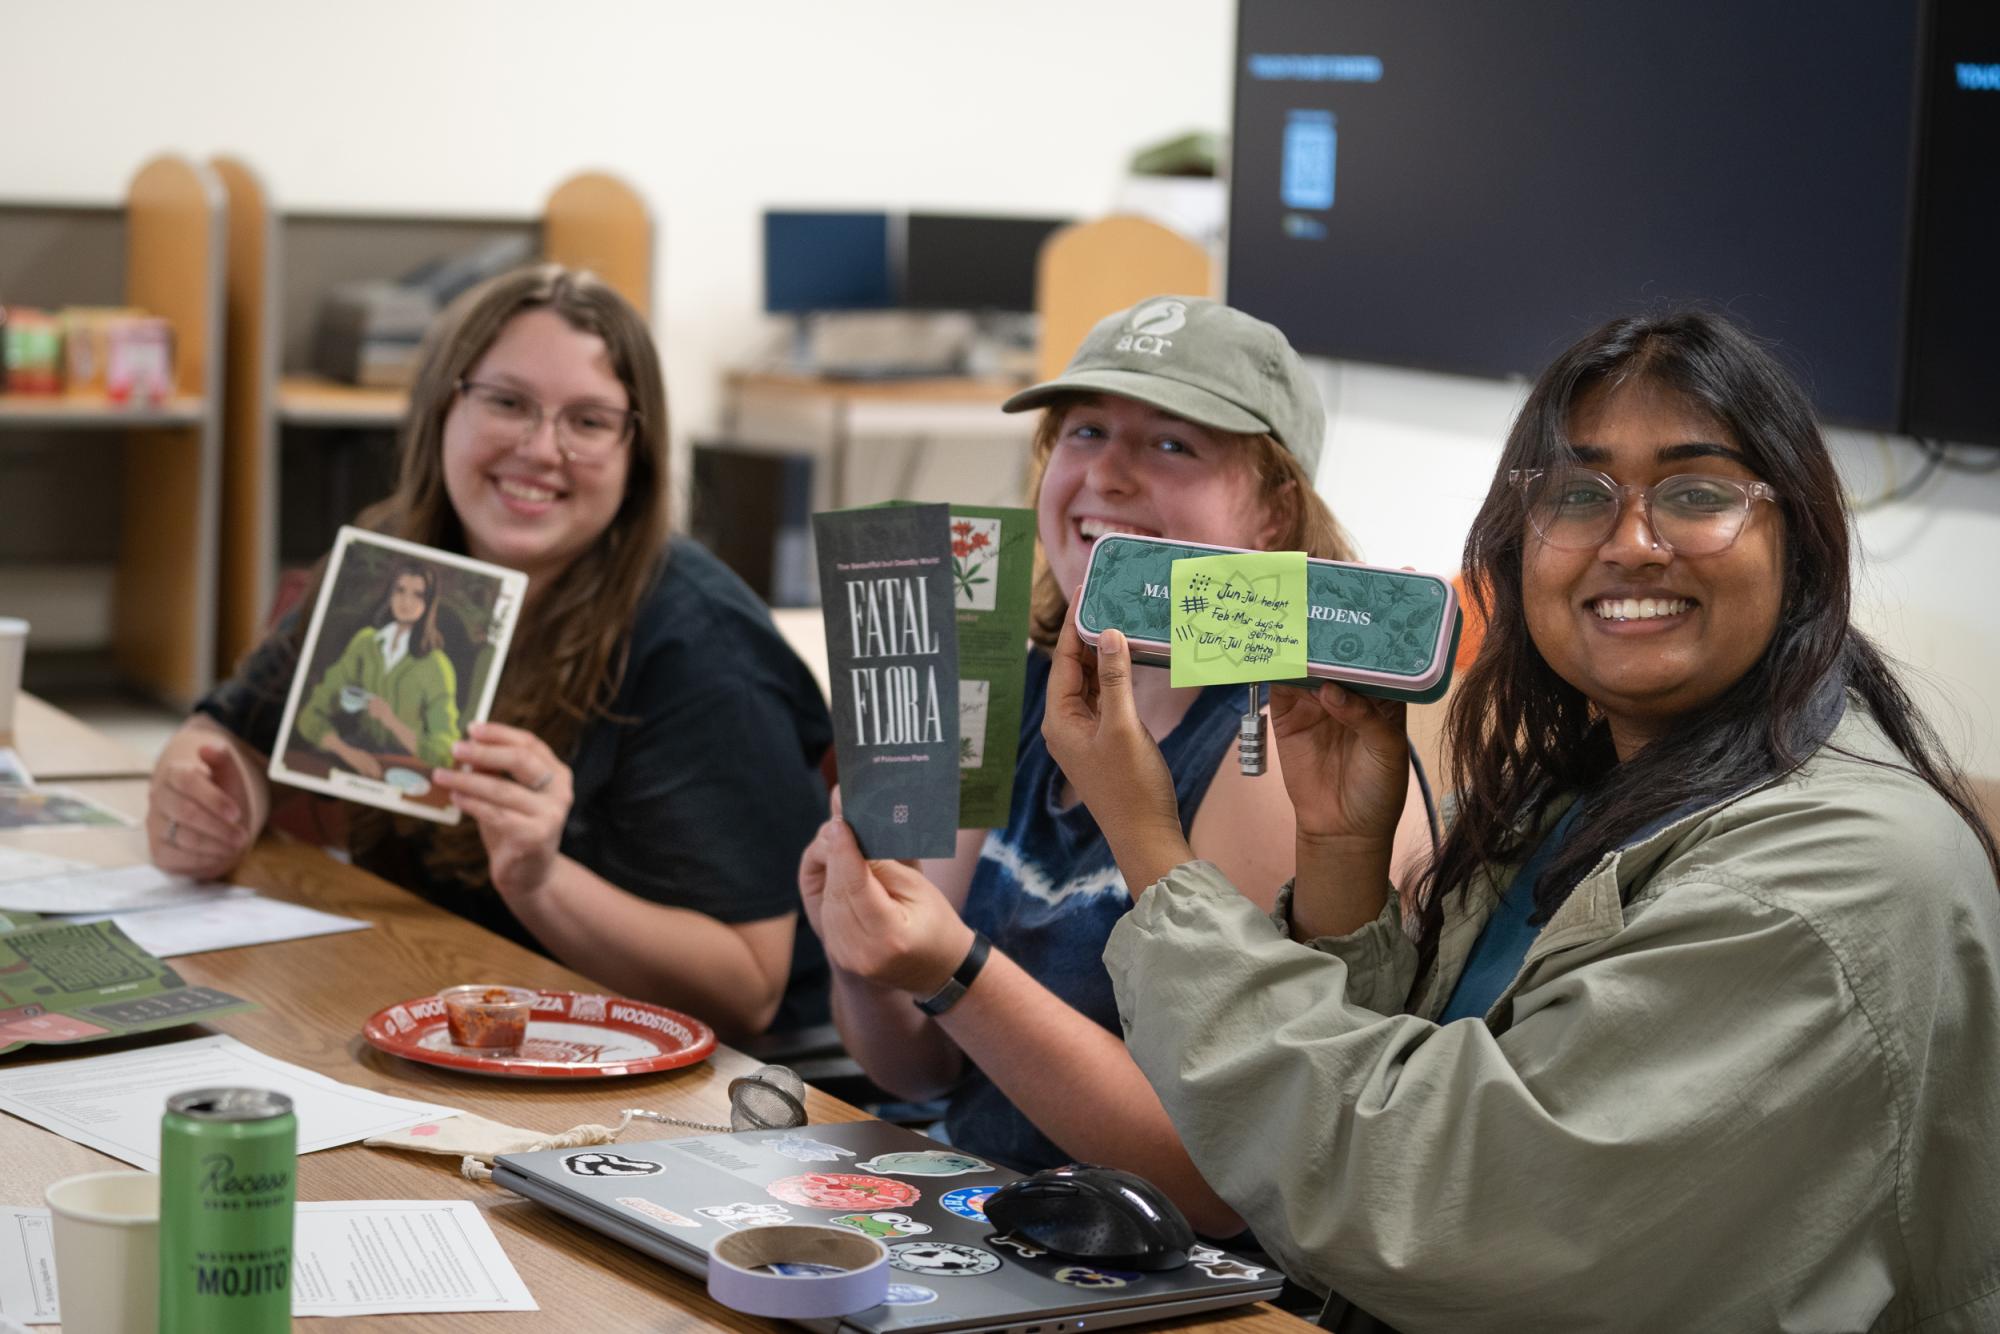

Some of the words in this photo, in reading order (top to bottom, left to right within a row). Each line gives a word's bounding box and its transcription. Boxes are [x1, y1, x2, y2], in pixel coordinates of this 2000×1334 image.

[846, 576, 940, 659] FATAL
[1307, 605, 1371, 626] RDENS
[850, 665, 945, 746] FLORA
